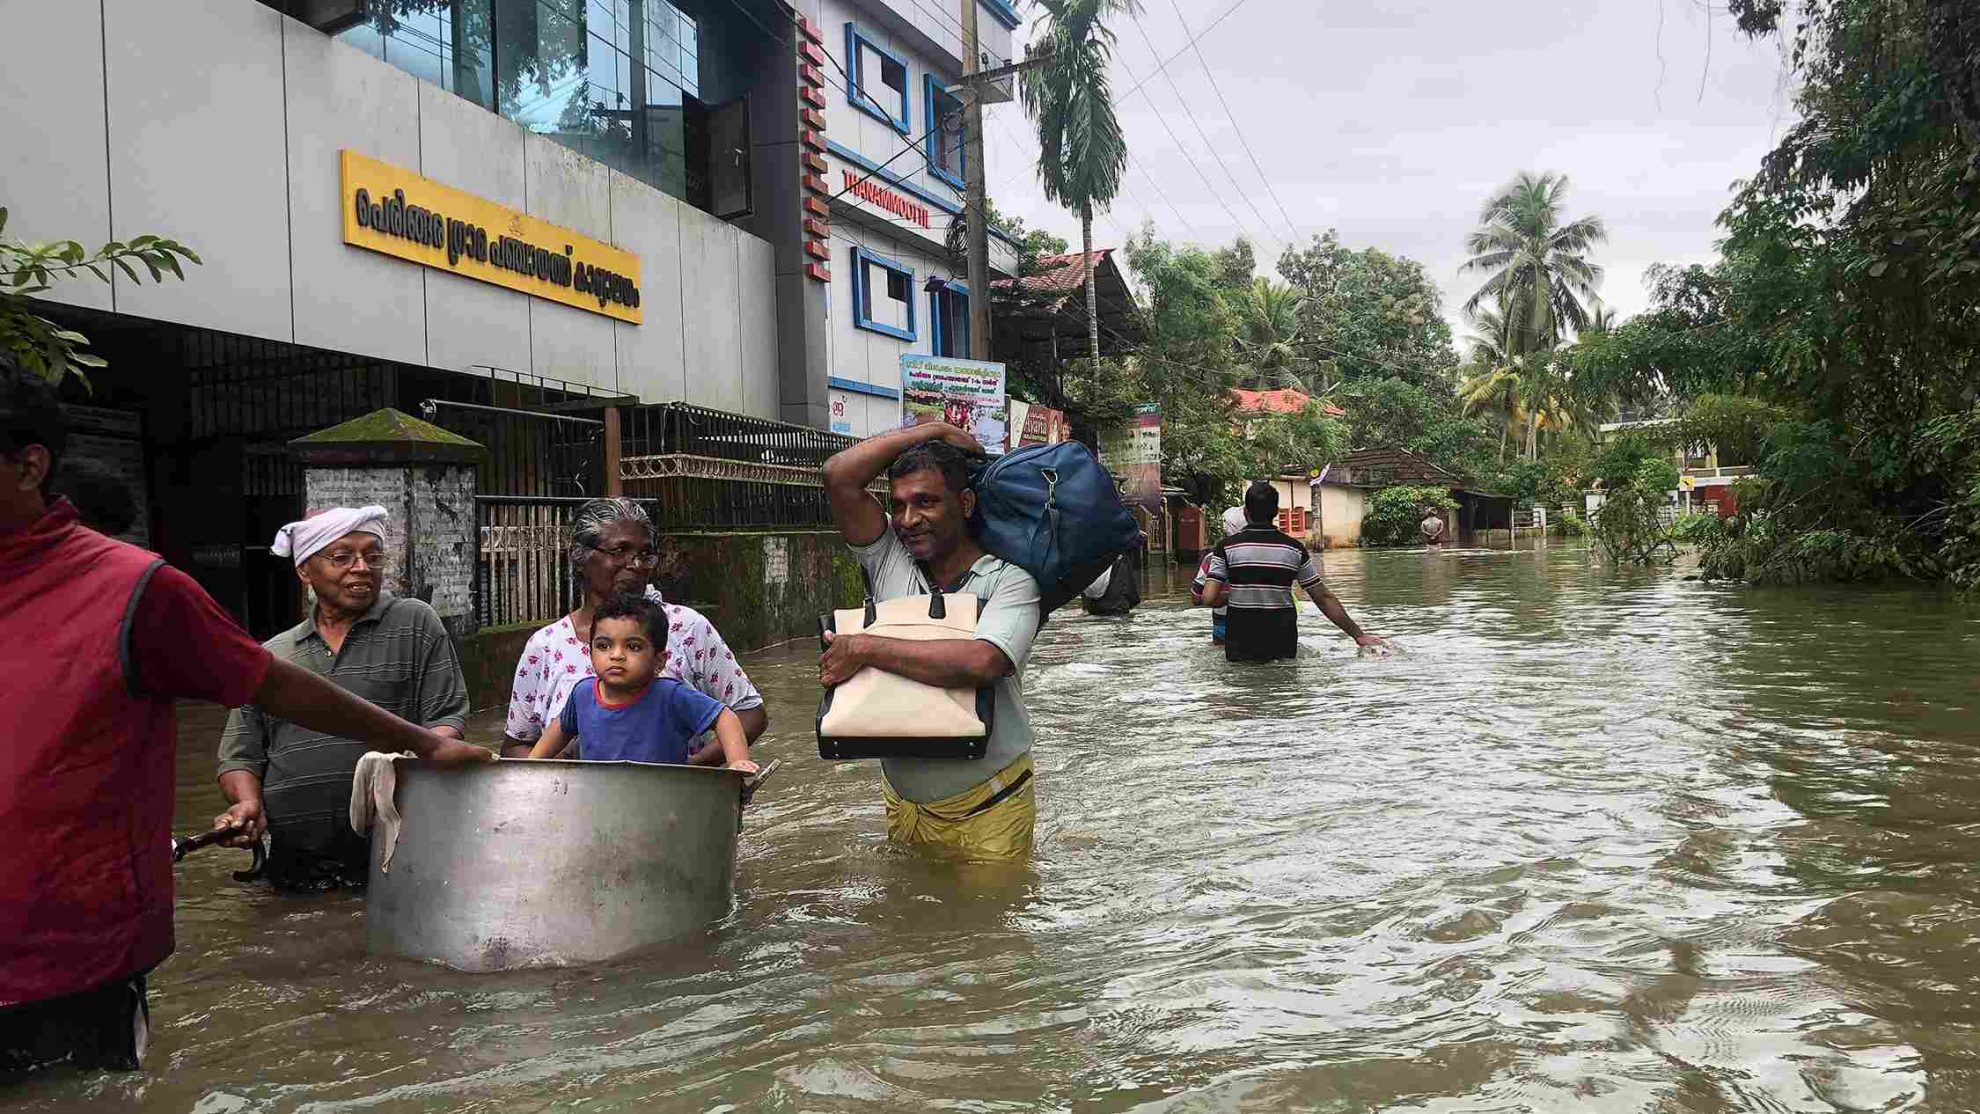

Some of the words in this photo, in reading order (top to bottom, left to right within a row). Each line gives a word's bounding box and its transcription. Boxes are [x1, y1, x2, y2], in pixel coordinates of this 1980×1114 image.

[356, 188, 444, 249] പെരിങ്ങര
[447, 217, 488, 265] ഗ്രാമ
[490, 235, 573, 287] പഞ്ചായത്ത്
